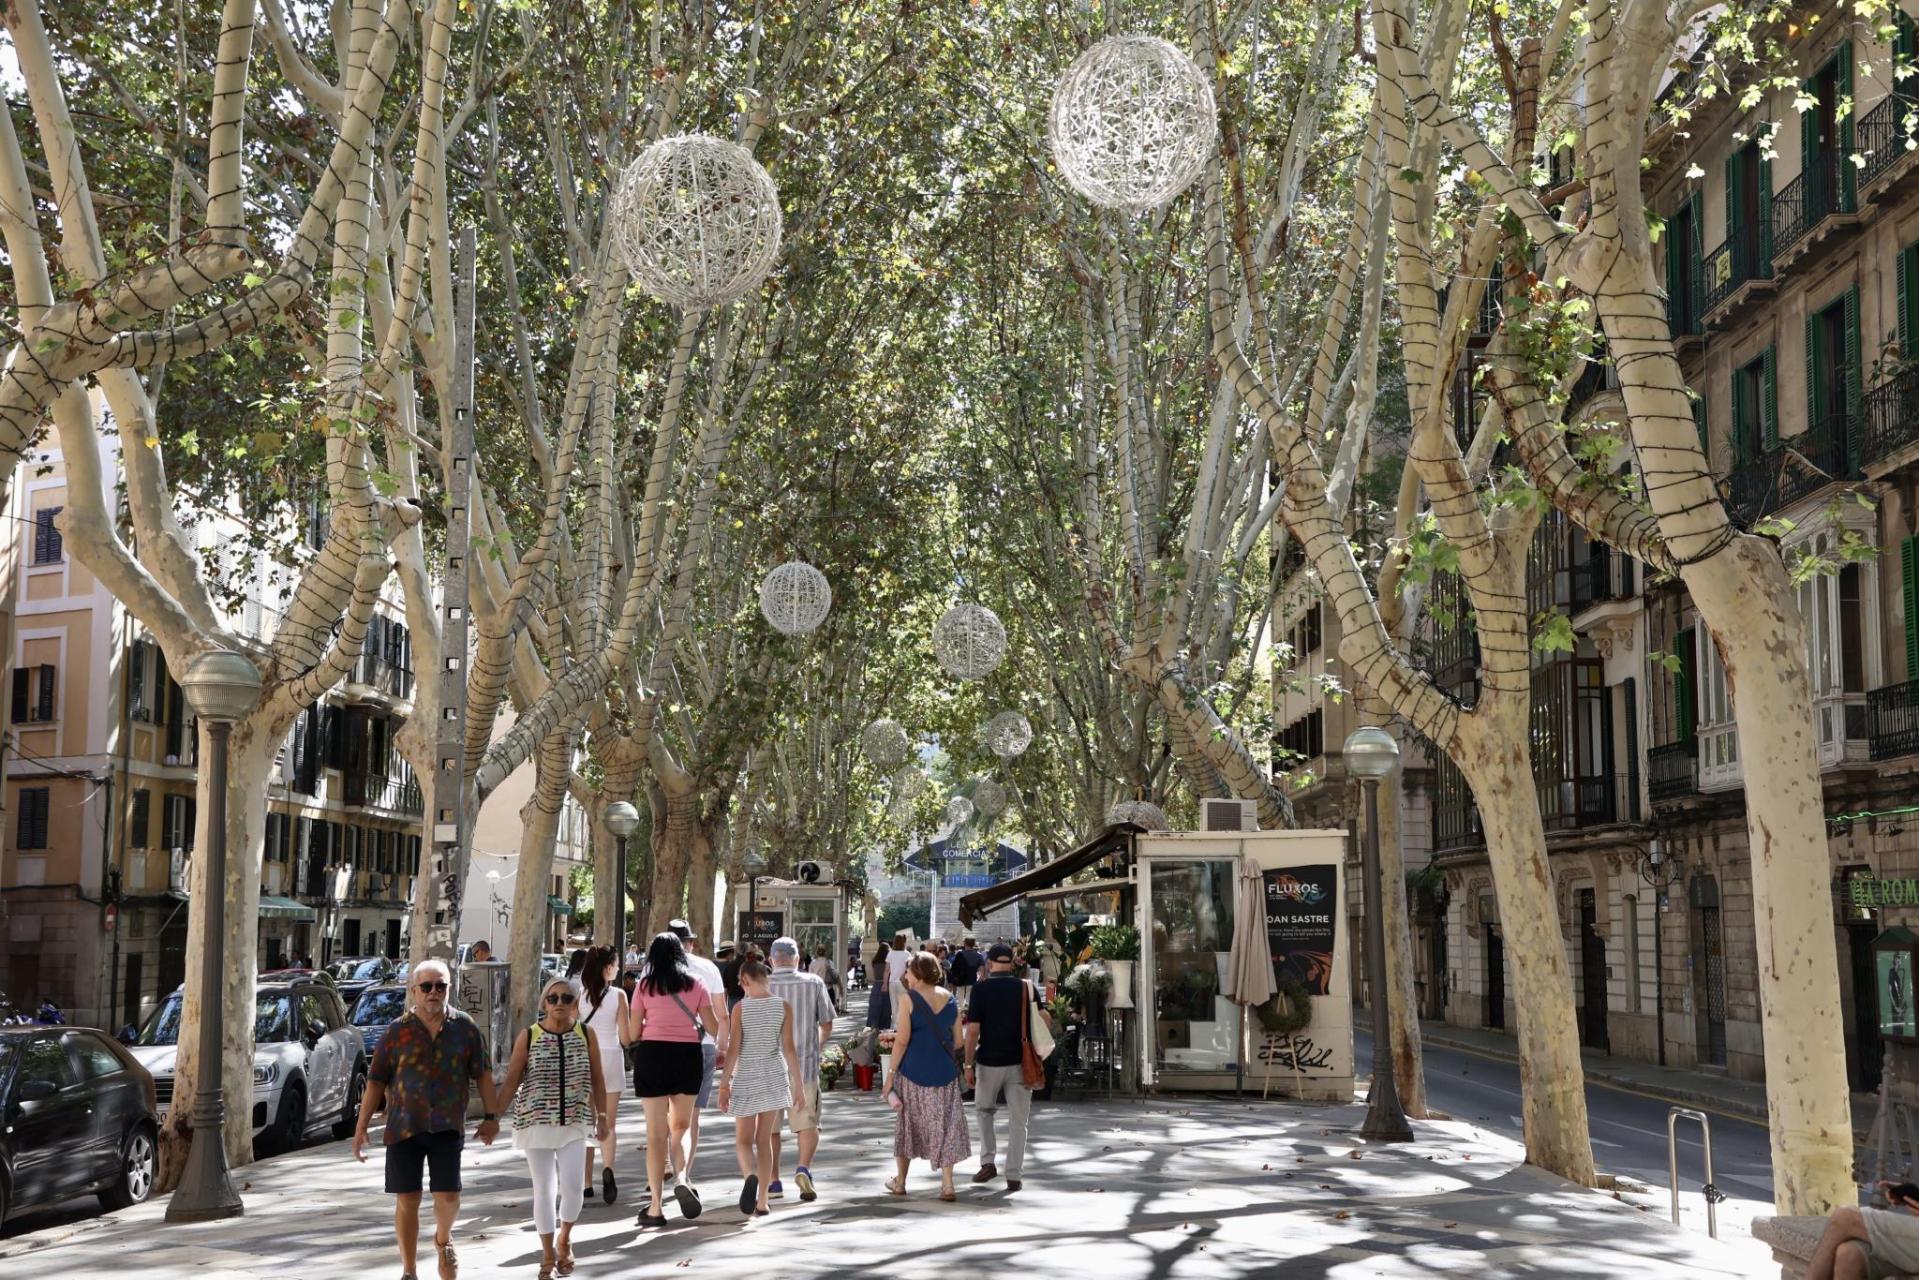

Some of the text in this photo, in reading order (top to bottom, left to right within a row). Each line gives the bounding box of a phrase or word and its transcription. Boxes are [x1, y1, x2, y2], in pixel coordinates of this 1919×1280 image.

[943, 849, 987, 858] COMERCIA
[1268, 883, 1319, 894] FLUXOS
[1265, 914, 1329, 923] OAN SASTRE
